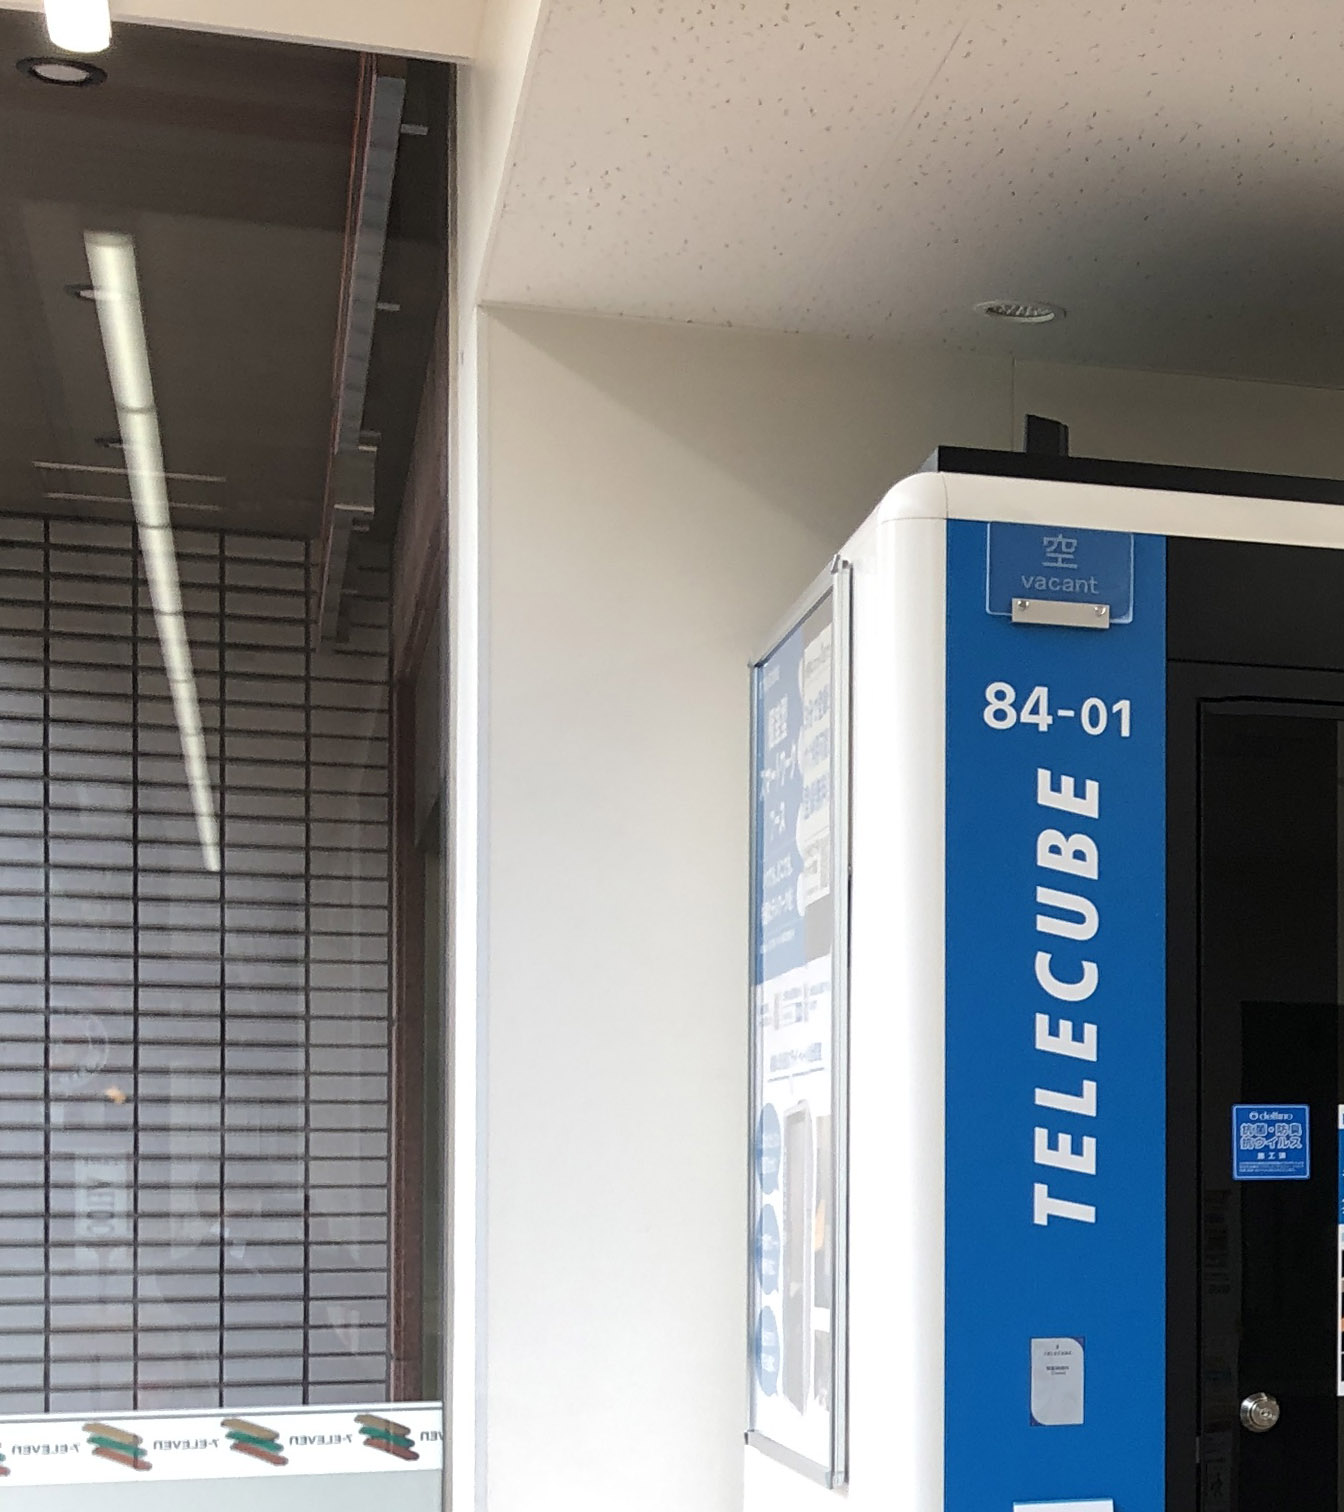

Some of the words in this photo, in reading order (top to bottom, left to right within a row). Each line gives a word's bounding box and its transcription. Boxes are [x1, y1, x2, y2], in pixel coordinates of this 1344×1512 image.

[1042, 533, 1078, 569] 空
[1021, 574, 1099, 594] vacant
[983, 681, 1131, 737] 84-01
[1033, 767, 1100, 1226] TELECUBE
